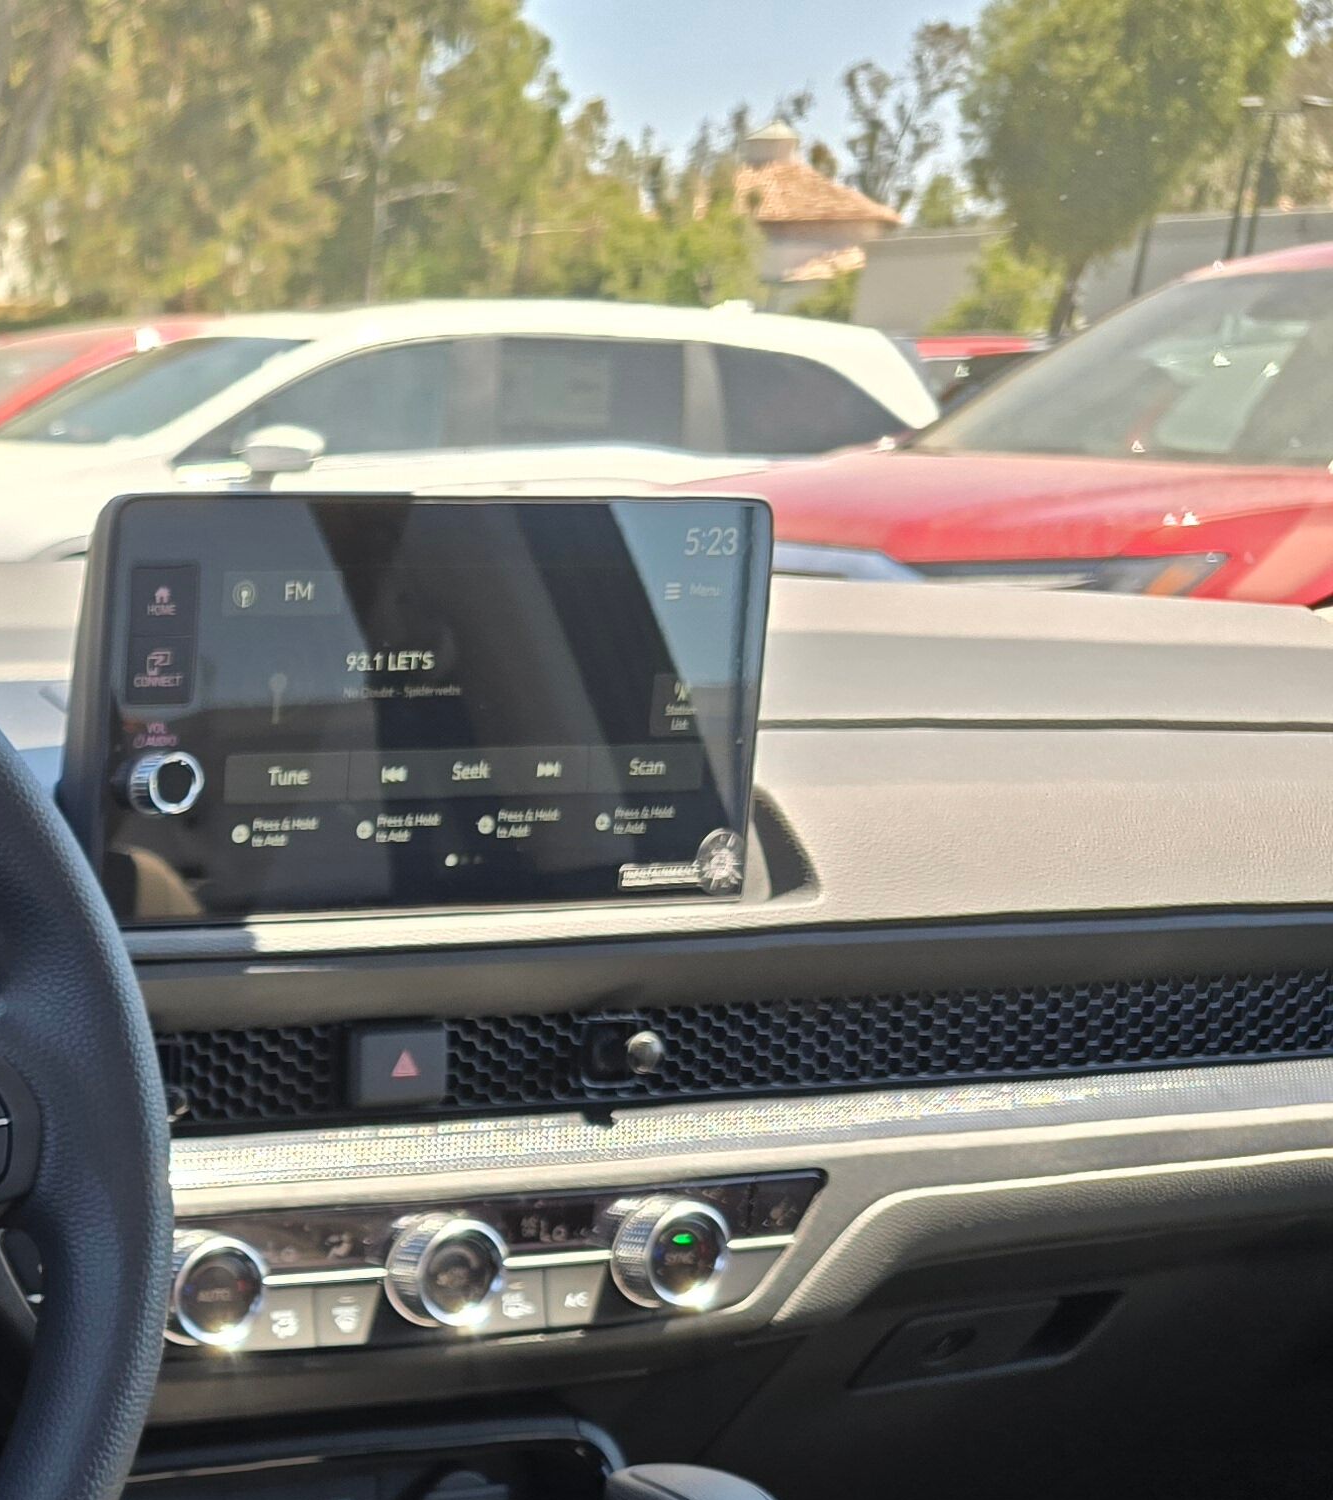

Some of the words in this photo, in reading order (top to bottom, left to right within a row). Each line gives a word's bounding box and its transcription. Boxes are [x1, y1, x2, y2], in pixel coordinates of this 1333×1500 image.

[684, 526, 739, 556] 5:23
[284, 580, 314, 601] FM
[146, 604, 177, 616] HOME
[345, 651, 383, 672] 93.1
[387, 650, 436, 672] LET'S
[134, 674, 183, 688] CONNECT
[146, 722, 168, 734] VOL
[267, 765, 311, 786] Tune
[451, 760, 492, 781] Seek
[629, 757, 667, 776] Scan
[196, 1286, 232, 1303] AUTO
